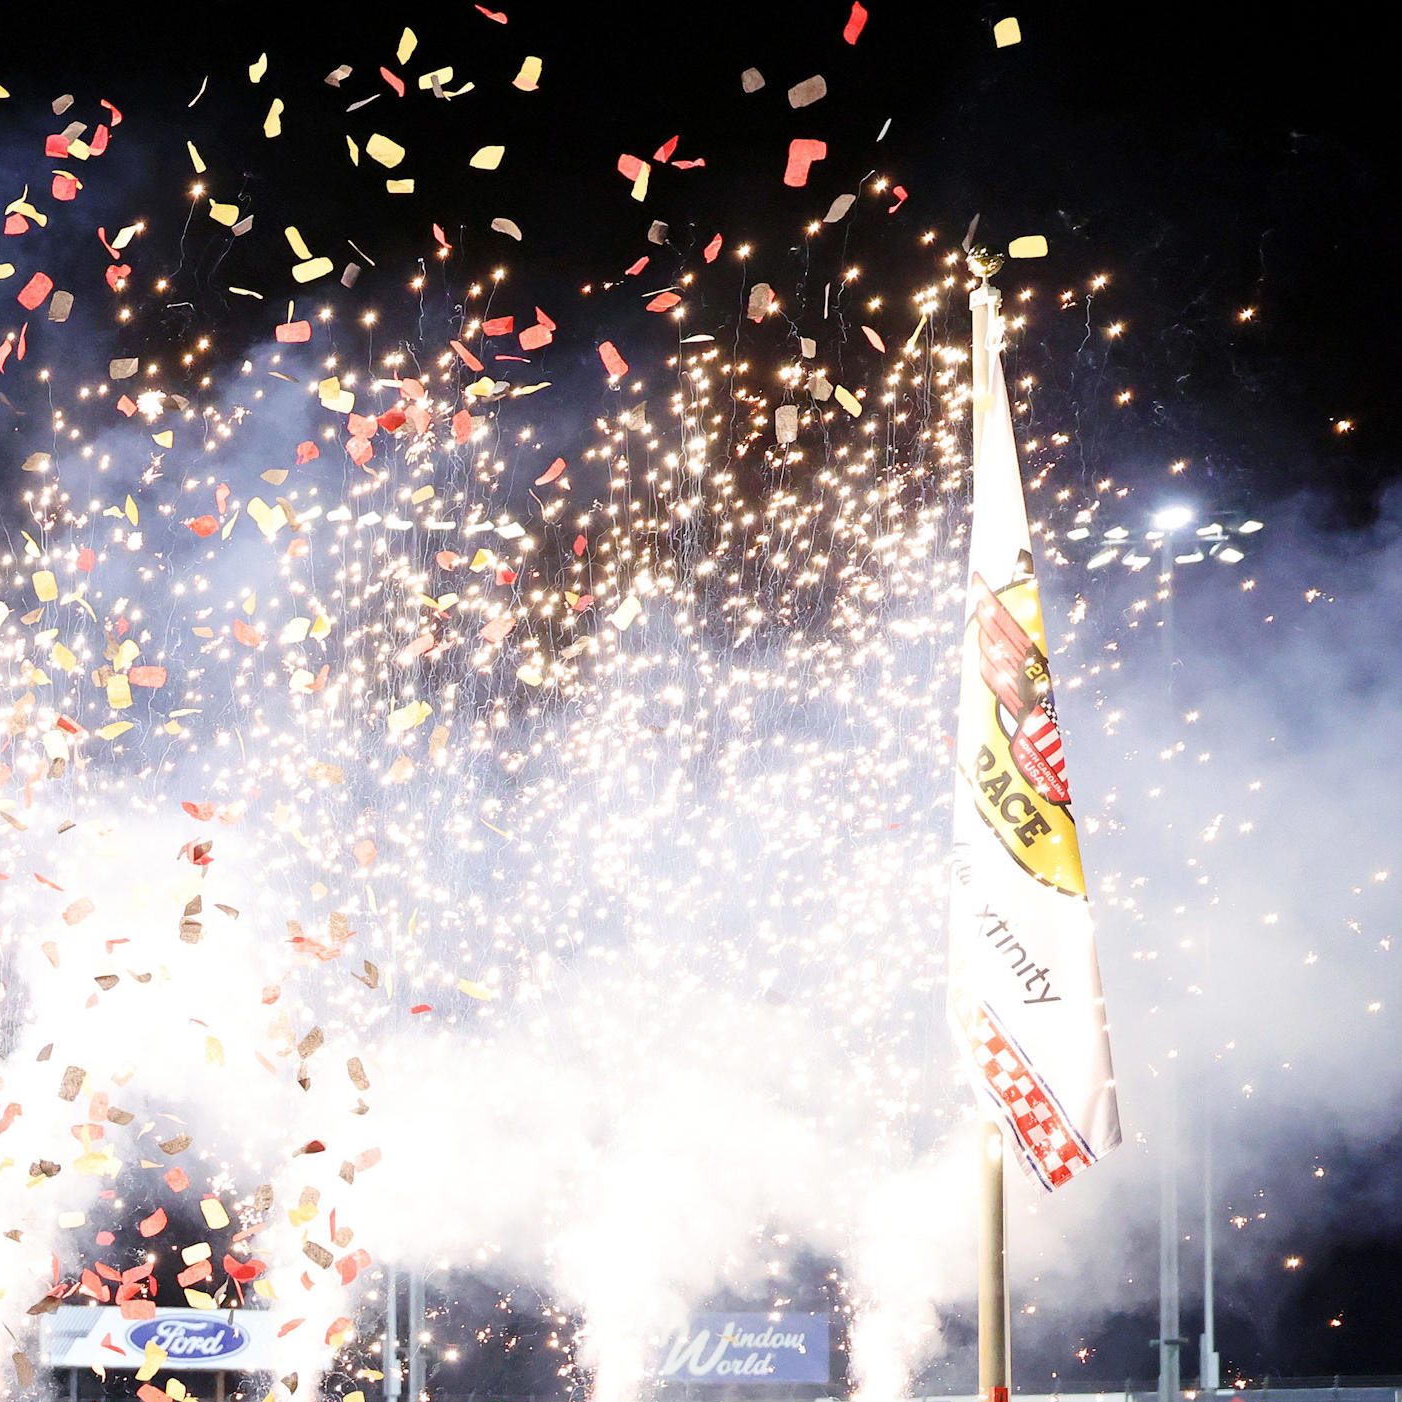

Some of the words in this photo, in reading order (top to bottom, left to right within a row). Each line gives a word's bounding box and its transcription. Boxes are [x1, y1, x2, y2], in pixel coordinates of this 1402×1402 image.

[974, 744, 1052, 848] RACE
[975, 904, 1062, 1004] xfinity
[148, 1318, 225, 1357] Ford
